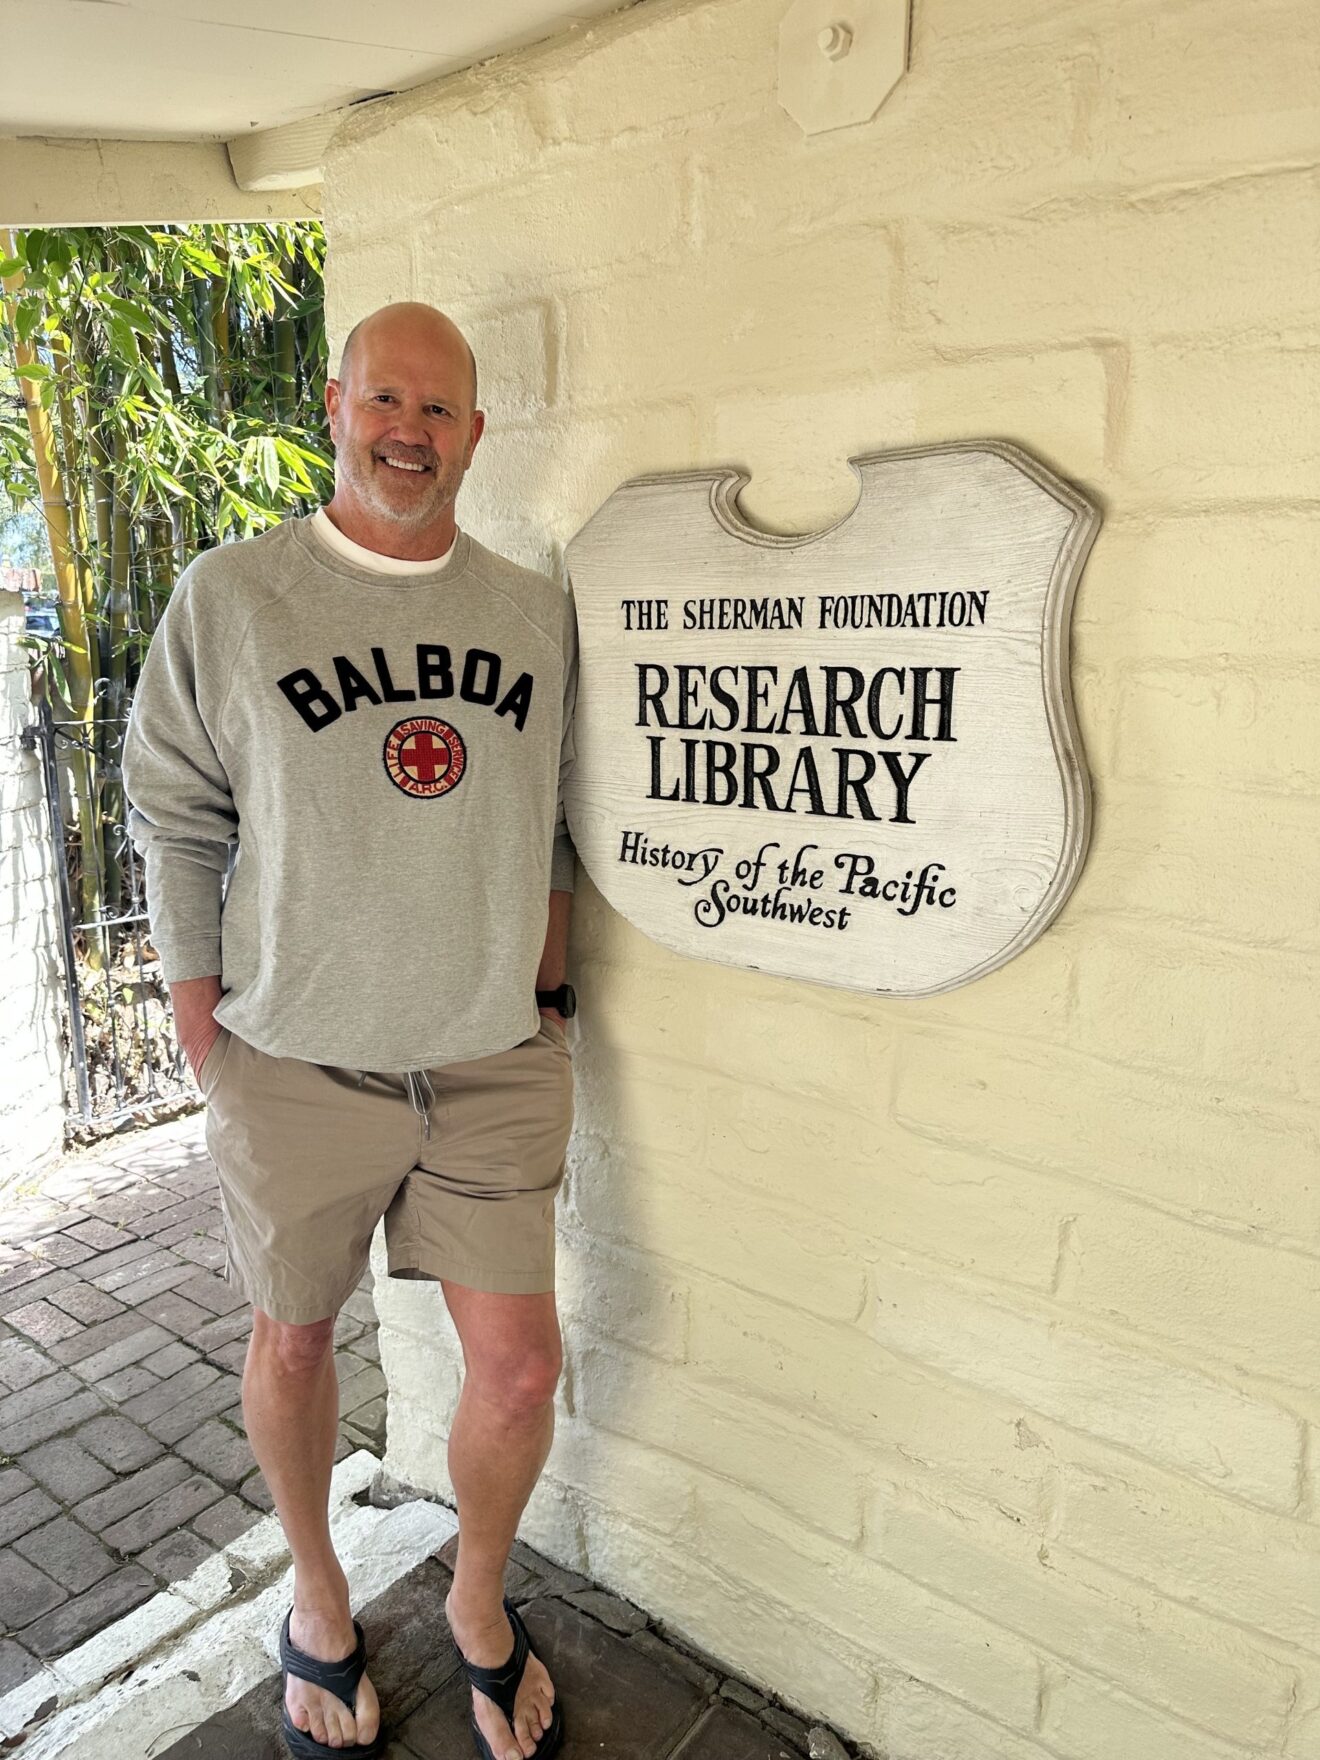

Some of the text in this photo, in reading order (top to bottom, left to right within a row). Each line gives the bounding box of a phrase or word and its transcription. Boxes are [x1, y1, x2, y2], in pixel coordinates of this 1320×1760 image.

[621, 590, 990, 631] THE SHERMAN FOUNDATION
[277, 643, 534, 733] BALBOA
[634, 663, 961, 742] RESEARCH
[387, 720, 463, 780] LIFE SAVING SERVICE
[645, 736, 932, 825] LIBRARY
[618, 831, 958, 917] History of the Pacific
[694, 879, 852, 930] Southwest
